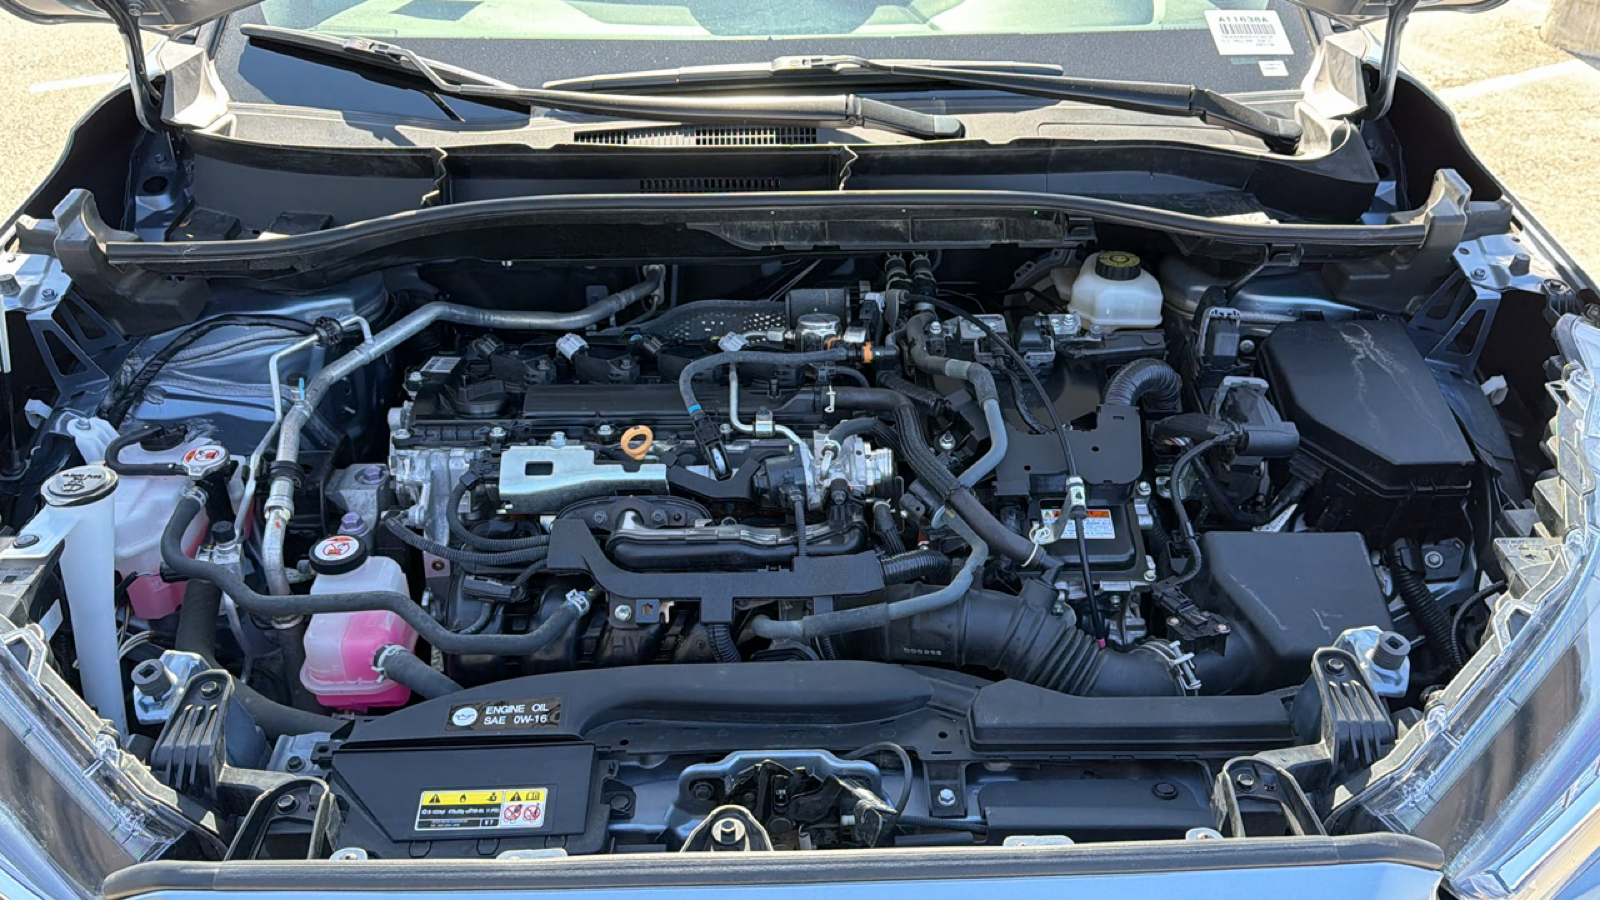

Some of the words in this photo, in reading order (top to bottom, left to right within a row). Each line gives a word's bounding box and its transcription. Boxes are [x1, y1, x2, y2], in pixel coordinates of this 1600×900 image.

[485, 704, 525, 715] ENGINE
[531, 703, 549, 712] OIL
[483, 715, 506, 725] SAE
